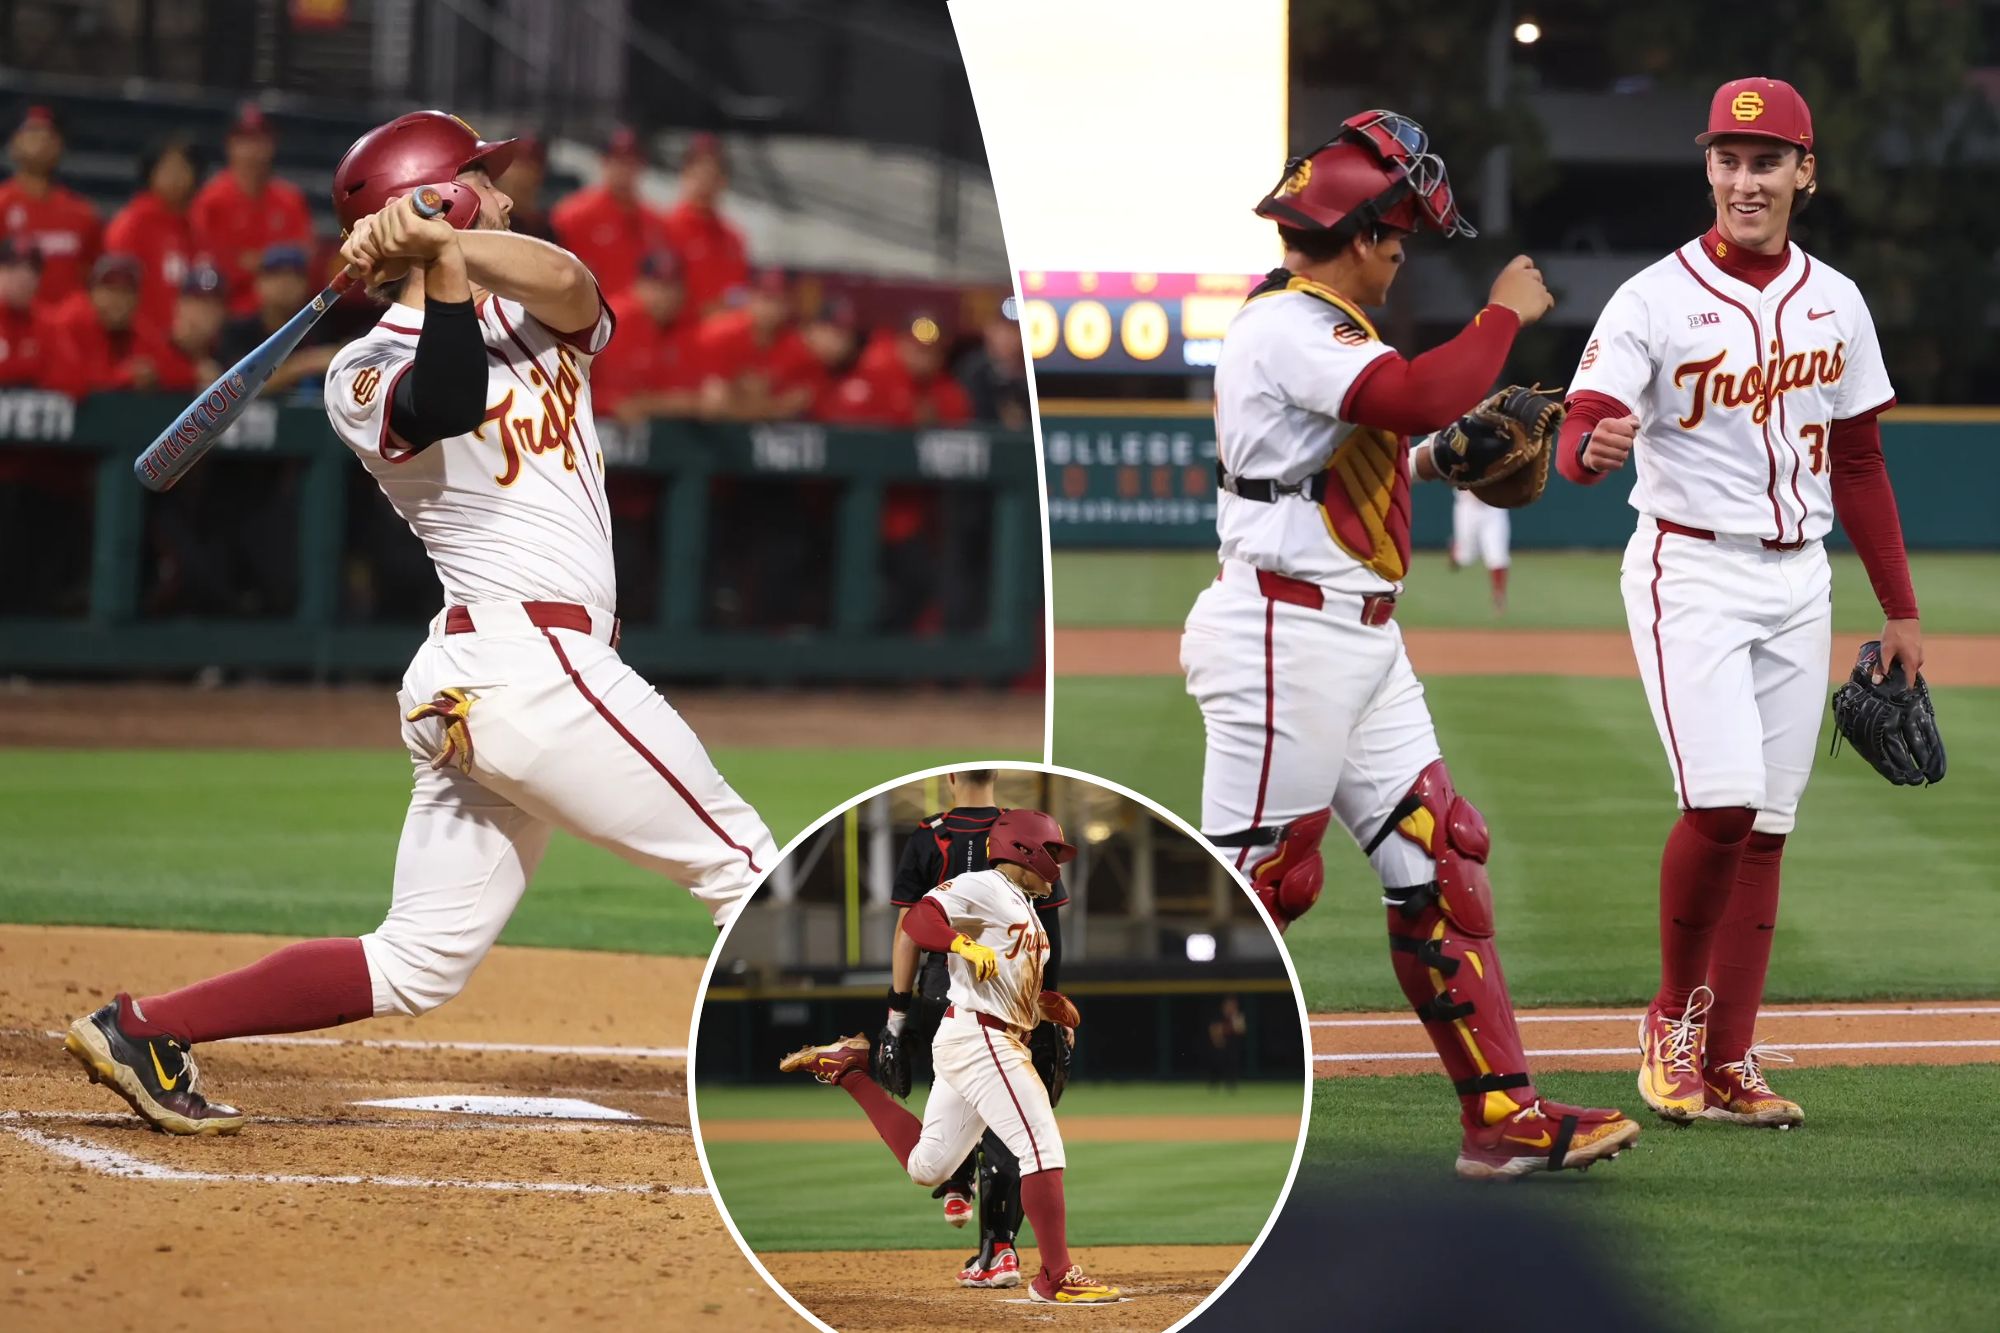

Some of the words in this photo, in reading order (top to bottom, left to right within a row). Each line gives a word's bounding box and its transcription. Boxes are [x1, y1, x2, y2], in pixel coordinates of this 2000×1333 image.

[1064, 300, 1112, 360] 0
[1121, 300, 1168, 360] 0
[1674, 339, 1847, 431] Trojans
[139, 379, 242, 481] LOUISVILLE
[1044, 431, 1194, 466] OLLEGE
[1799, 421, 1831, 476] 3
